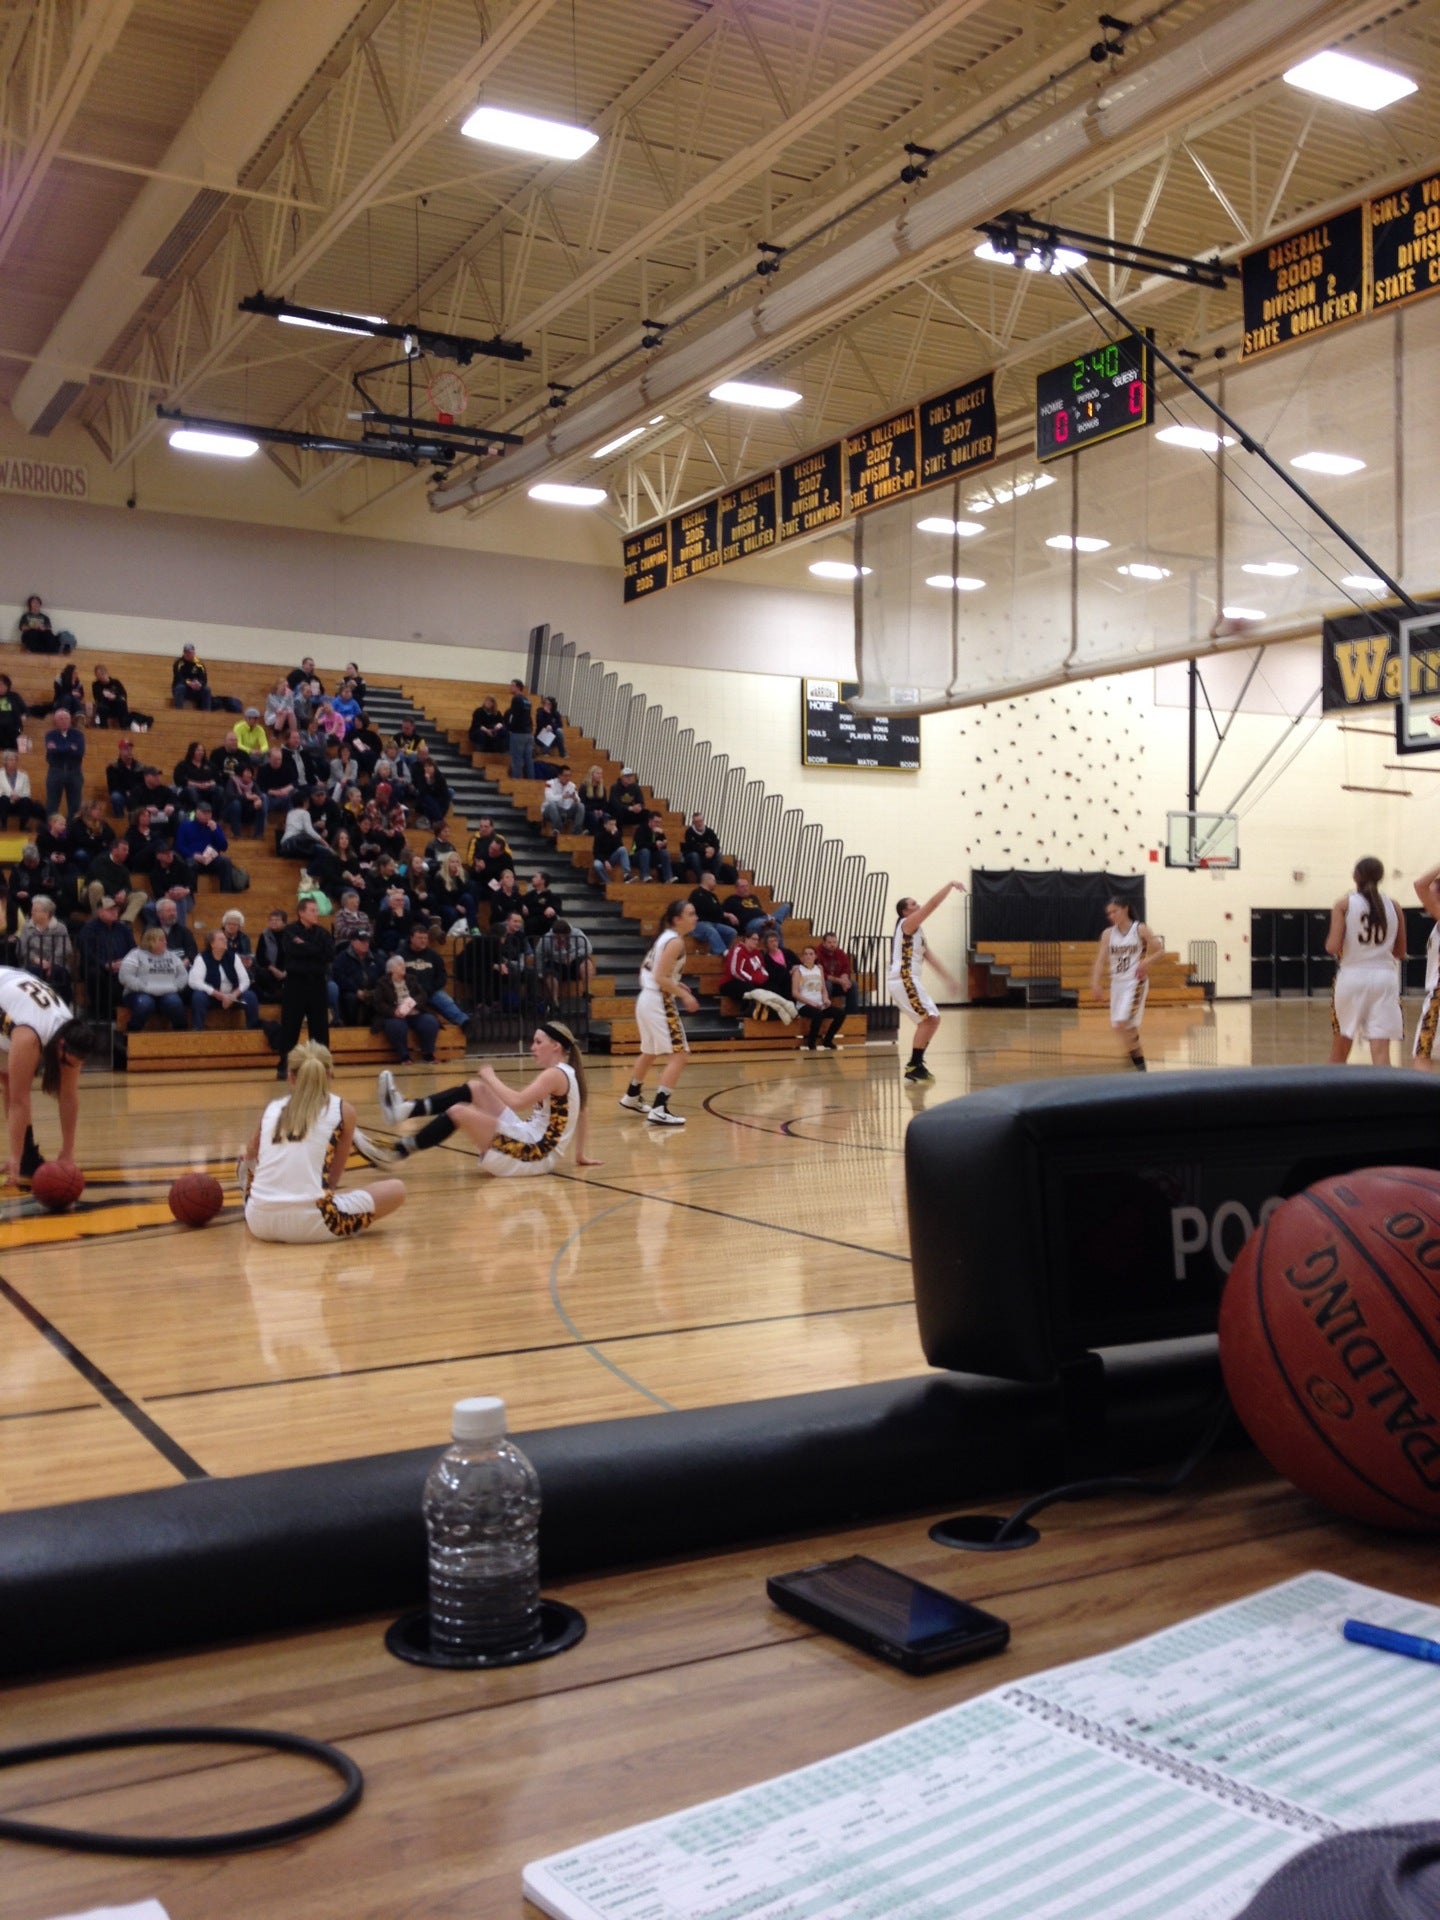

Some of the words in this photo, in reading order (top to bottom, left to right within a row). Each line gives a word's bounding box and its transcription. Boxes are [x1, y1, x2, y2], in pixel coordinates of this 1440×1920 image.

[1371, 192, 1410, 226] GIRLS
[1268, 225, 1332, 271] BASEBALL
[1277, 253, 1324, 292] 2008
[1375, 267, 1416, 304] STATE
[1263, 281, 1316, 322] DIVISION
[1327, 273, 1336, 297] 2
[1245, 320, 1280, 354] STATE
[1291, 290, 1358, 336] QUALIFIER
[1072, 344, 1119, 392] 2:40
[1112, 368, 1139, 388] GUEST
[929, 403, 950, 426] GIRLS
[955, 387, 986, 416] HOCKEY
[1041, 398, 1064, 416] HOME
[1129, 380, 1145, 414] 0
[871, 414, 915, 446] VOLLEYBALL
[943, 418, 972, 445] 2007
[1055, 409, 1069, 443] 0
[867, 441, 894, 466] 2007
[924, 453, 946, 476] STATE
[951, 435, 993, 467] QUALIFIER
[860, 461, 890, 488] DIVISION
[850, 488, 868, 509] STATE
[809, 701, 834, 711] HOME
[807, 729, 827, 738] FOULS
[839, 723, 856, 731] BONUS
[849, 732, 871, 740] PLAYER
[873, 734, 888, 742] FOUL
[872, 725, 889, 733] BONUS
[901, 735, 920, 744] FOULS
[857, 759, 878, 767] MATCH
